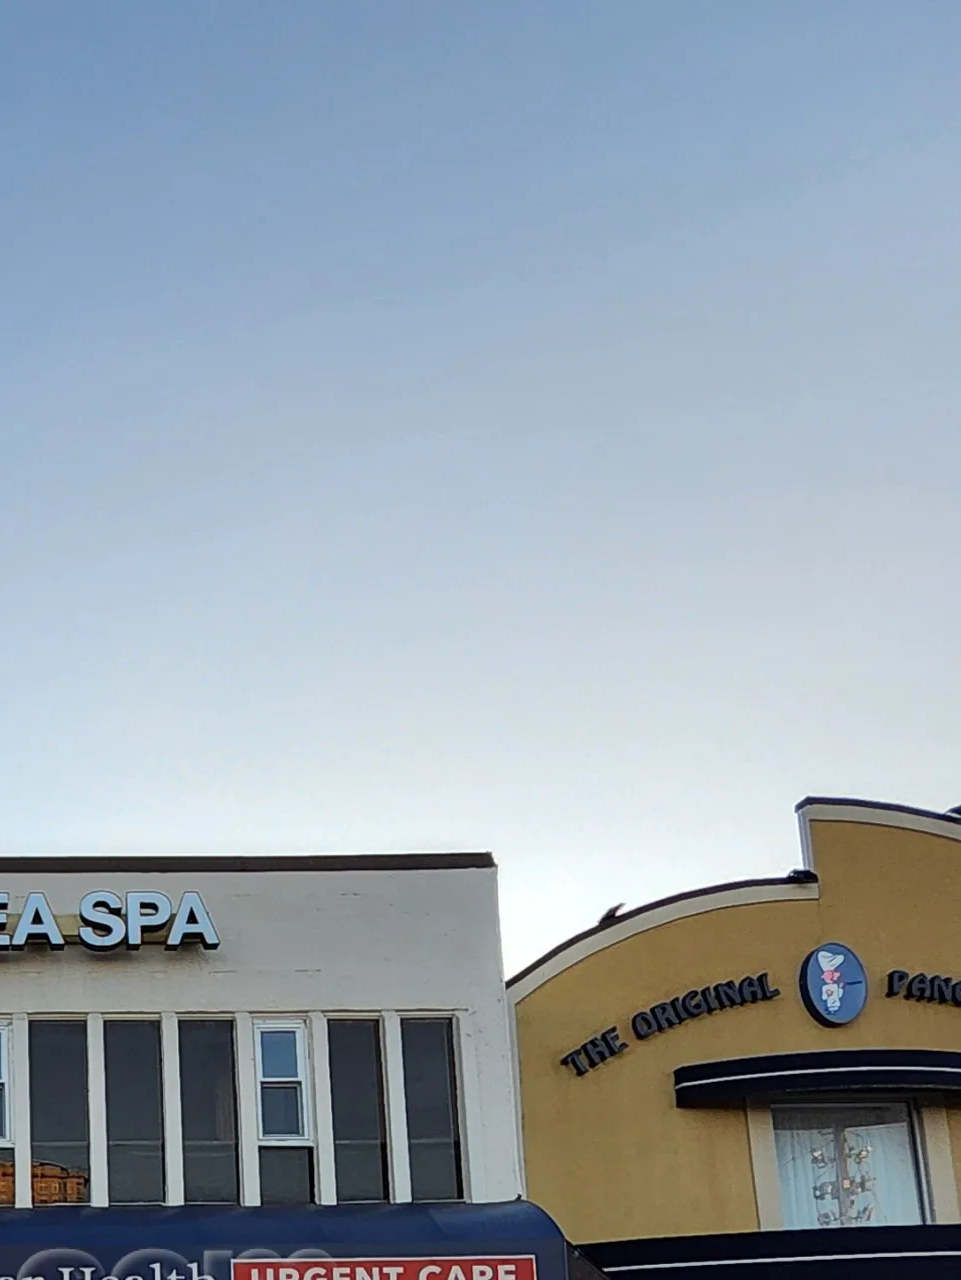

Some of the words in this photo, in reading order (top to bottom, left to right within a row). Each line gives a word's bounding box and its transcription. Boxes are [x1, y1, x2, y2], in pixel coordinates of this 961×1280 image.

[78, 889, 221, 952] SPA
[560, 1026, 629, 1077] THE
[631, 972, 781, 1040] ORIGINAL
